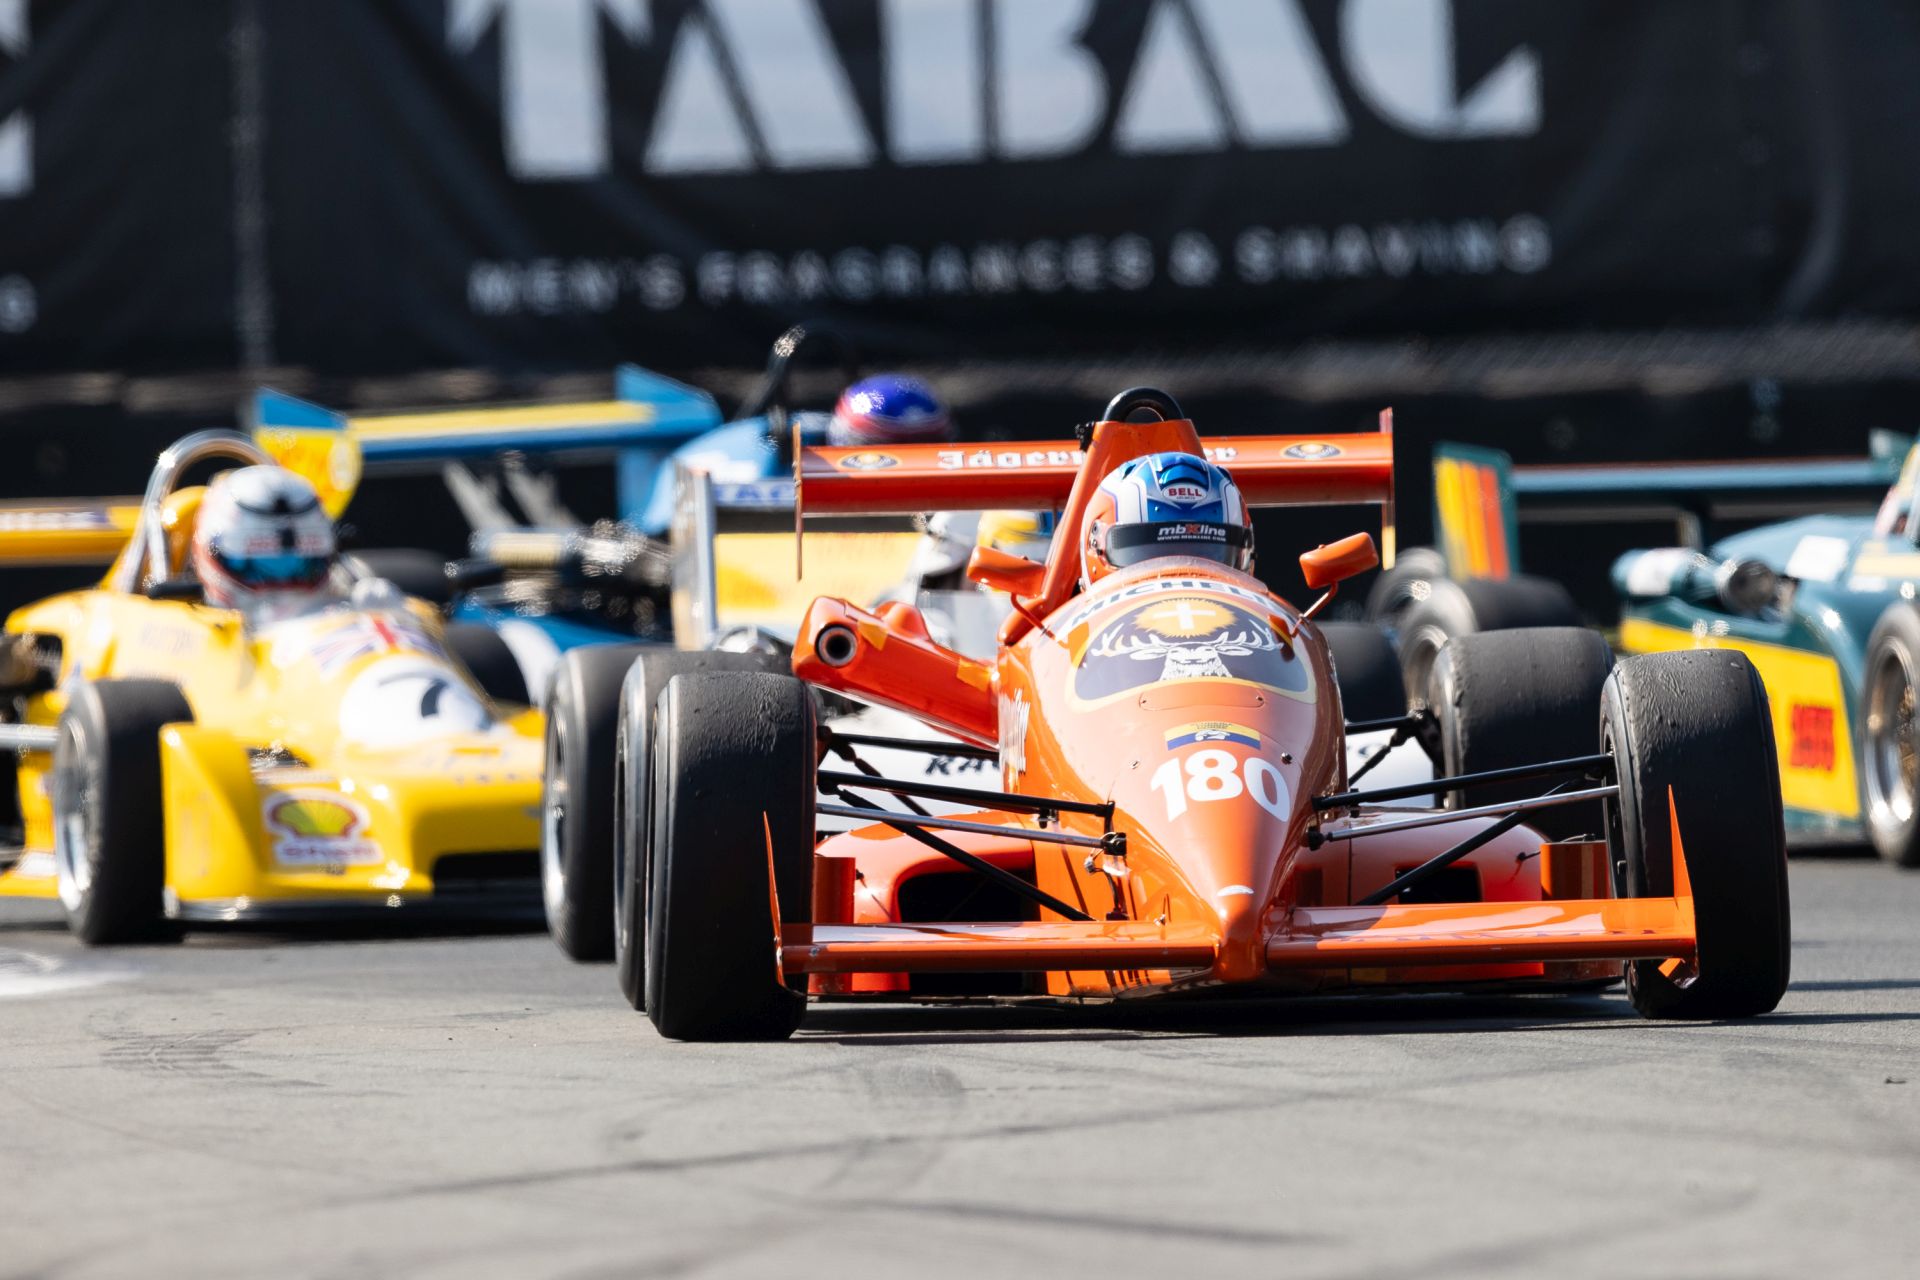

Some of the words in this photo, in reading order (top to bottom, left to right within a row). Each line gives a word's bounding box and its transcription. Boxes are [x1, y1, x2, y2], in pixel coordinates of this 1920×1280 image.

[445, 0, 1543, 179] TABAC
[469, 254, 685, 312] MEN'S
[702, 234, 1154, 305] FRAGRANCES
[1169, 231, 1219, 286] &
[1235, 213, 1551, 283] SHAVING
[1168, 488, 1203, 496] BELL
[1151, 749, 1291, 822] 180
